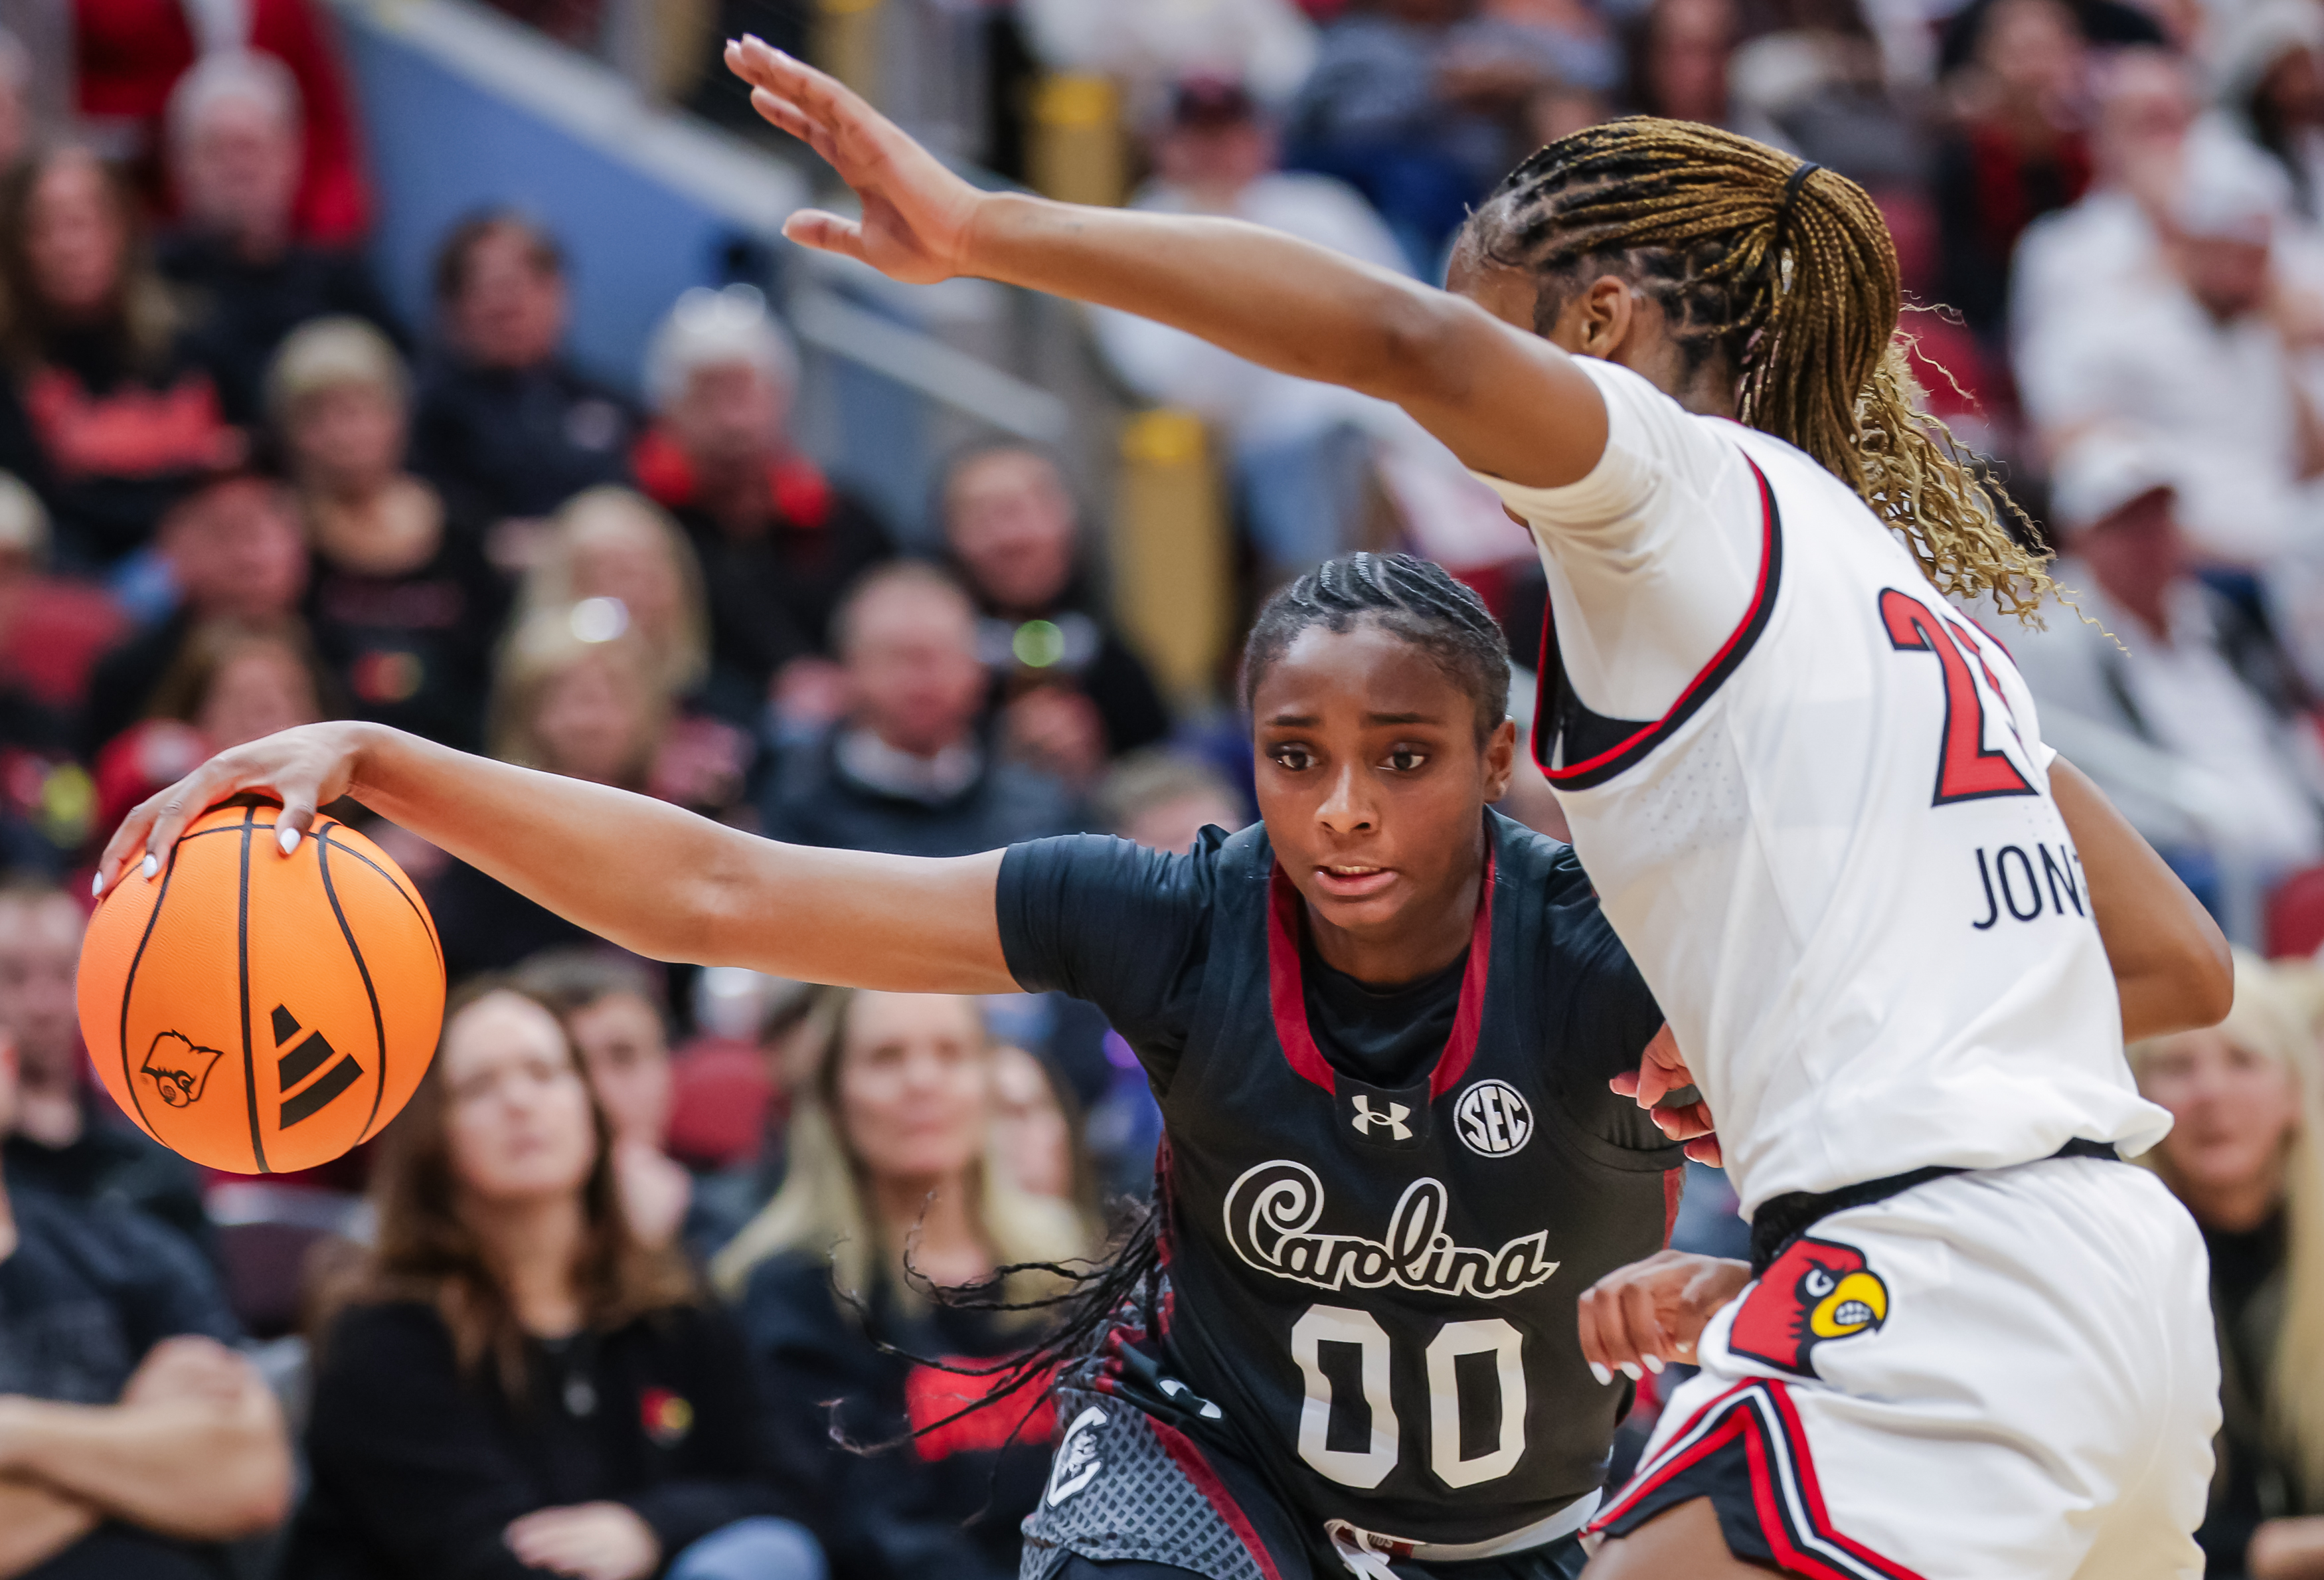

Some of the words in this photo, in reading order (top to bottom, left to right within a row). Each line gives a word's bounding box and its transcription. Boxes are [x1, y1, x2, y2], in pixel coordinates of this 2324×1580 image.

[1972, 843, 2088, 930] JON
[1461, 1086, 1527, 1152] SEC
[1223, 1160, 1560, 1298] Carolina
[1291, 1304, 1527, 1489] 00
